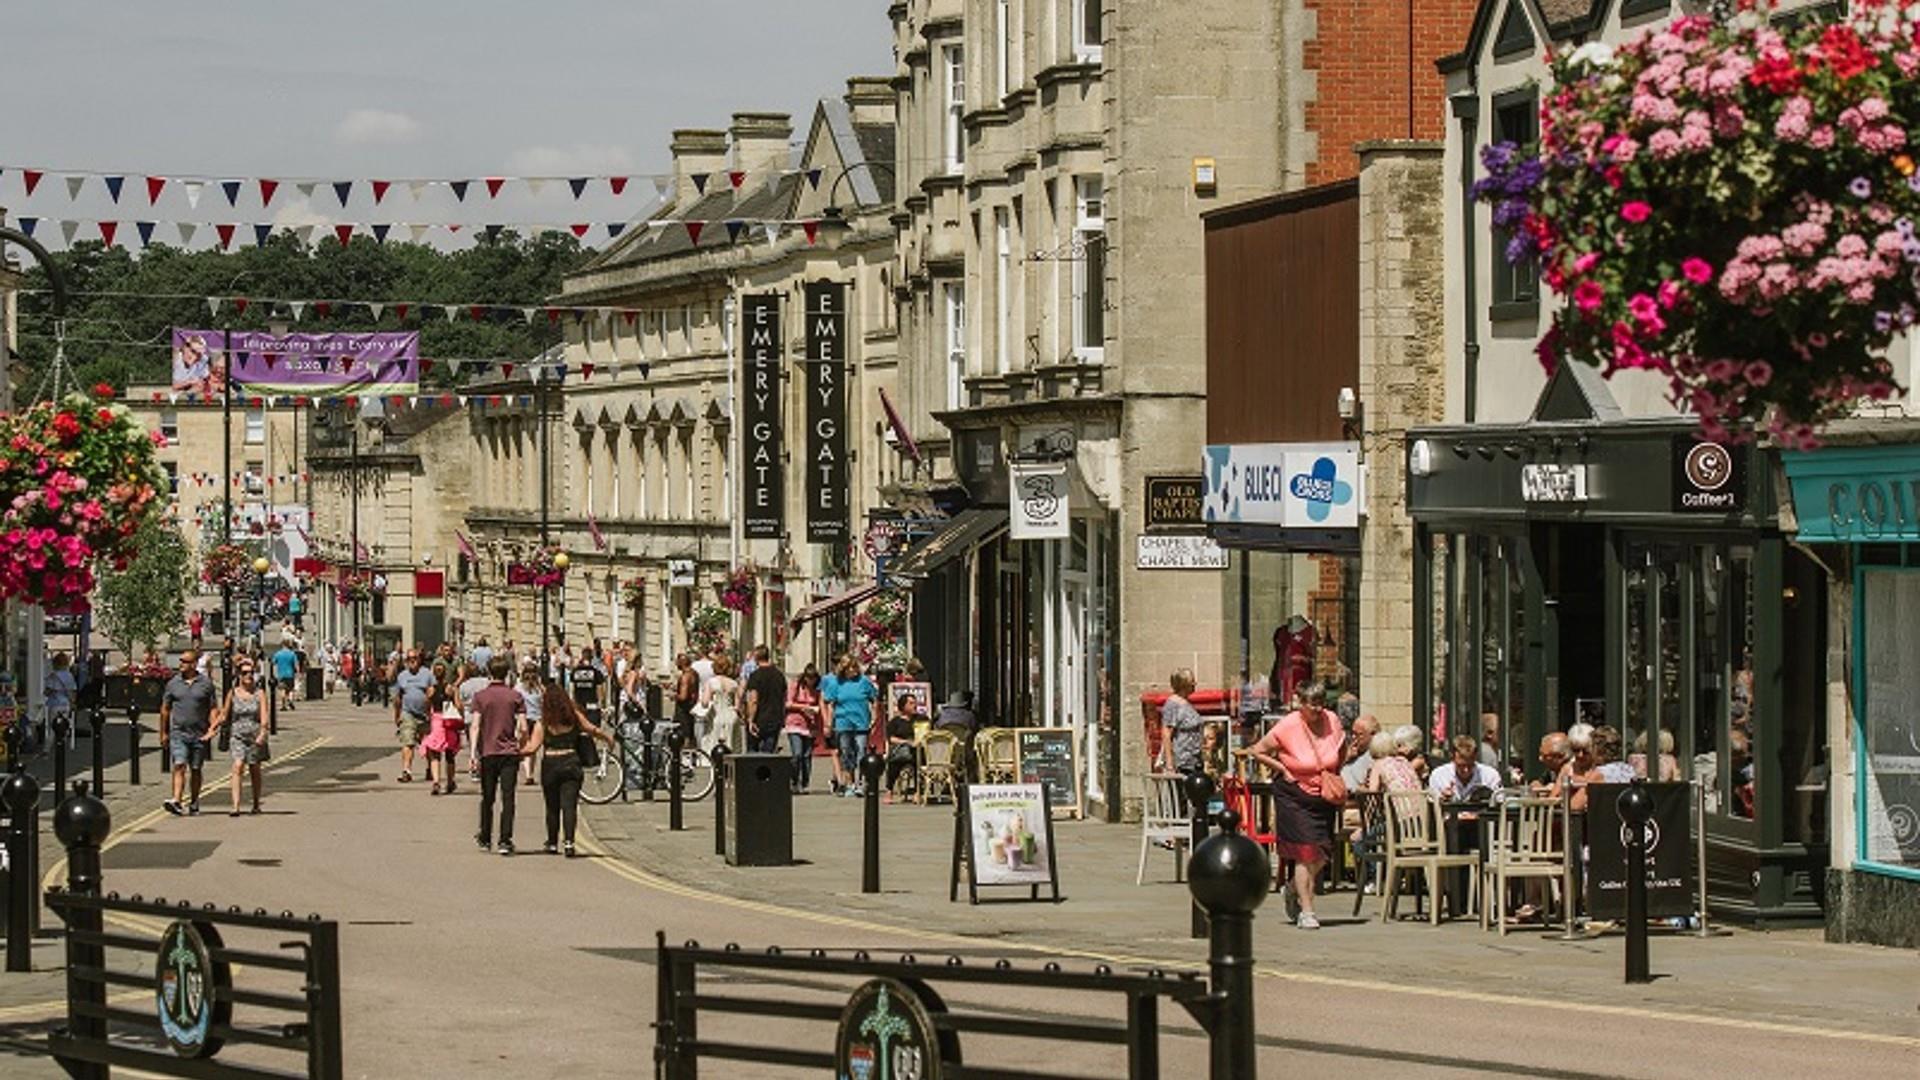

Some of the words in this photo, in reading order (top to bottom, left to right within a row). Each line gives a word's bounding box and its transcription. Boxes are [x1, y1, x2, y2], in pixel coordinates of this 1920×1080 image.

[751, 306, 772, 411] EMERY
[815, 294, 836, 406] EMERY
[753, 423, 772, 506] GATE
[816, 419, 836, 508] GATE
[1166, 486, 1196, 498] OLD
[1245, 466, 1270, 500] BLUE
[1138, 554, 1185, 566] CHAPEL
[1191, 554, 1227, 566] MEWS
[1141, 538, 1188, 549] CHAPEL
